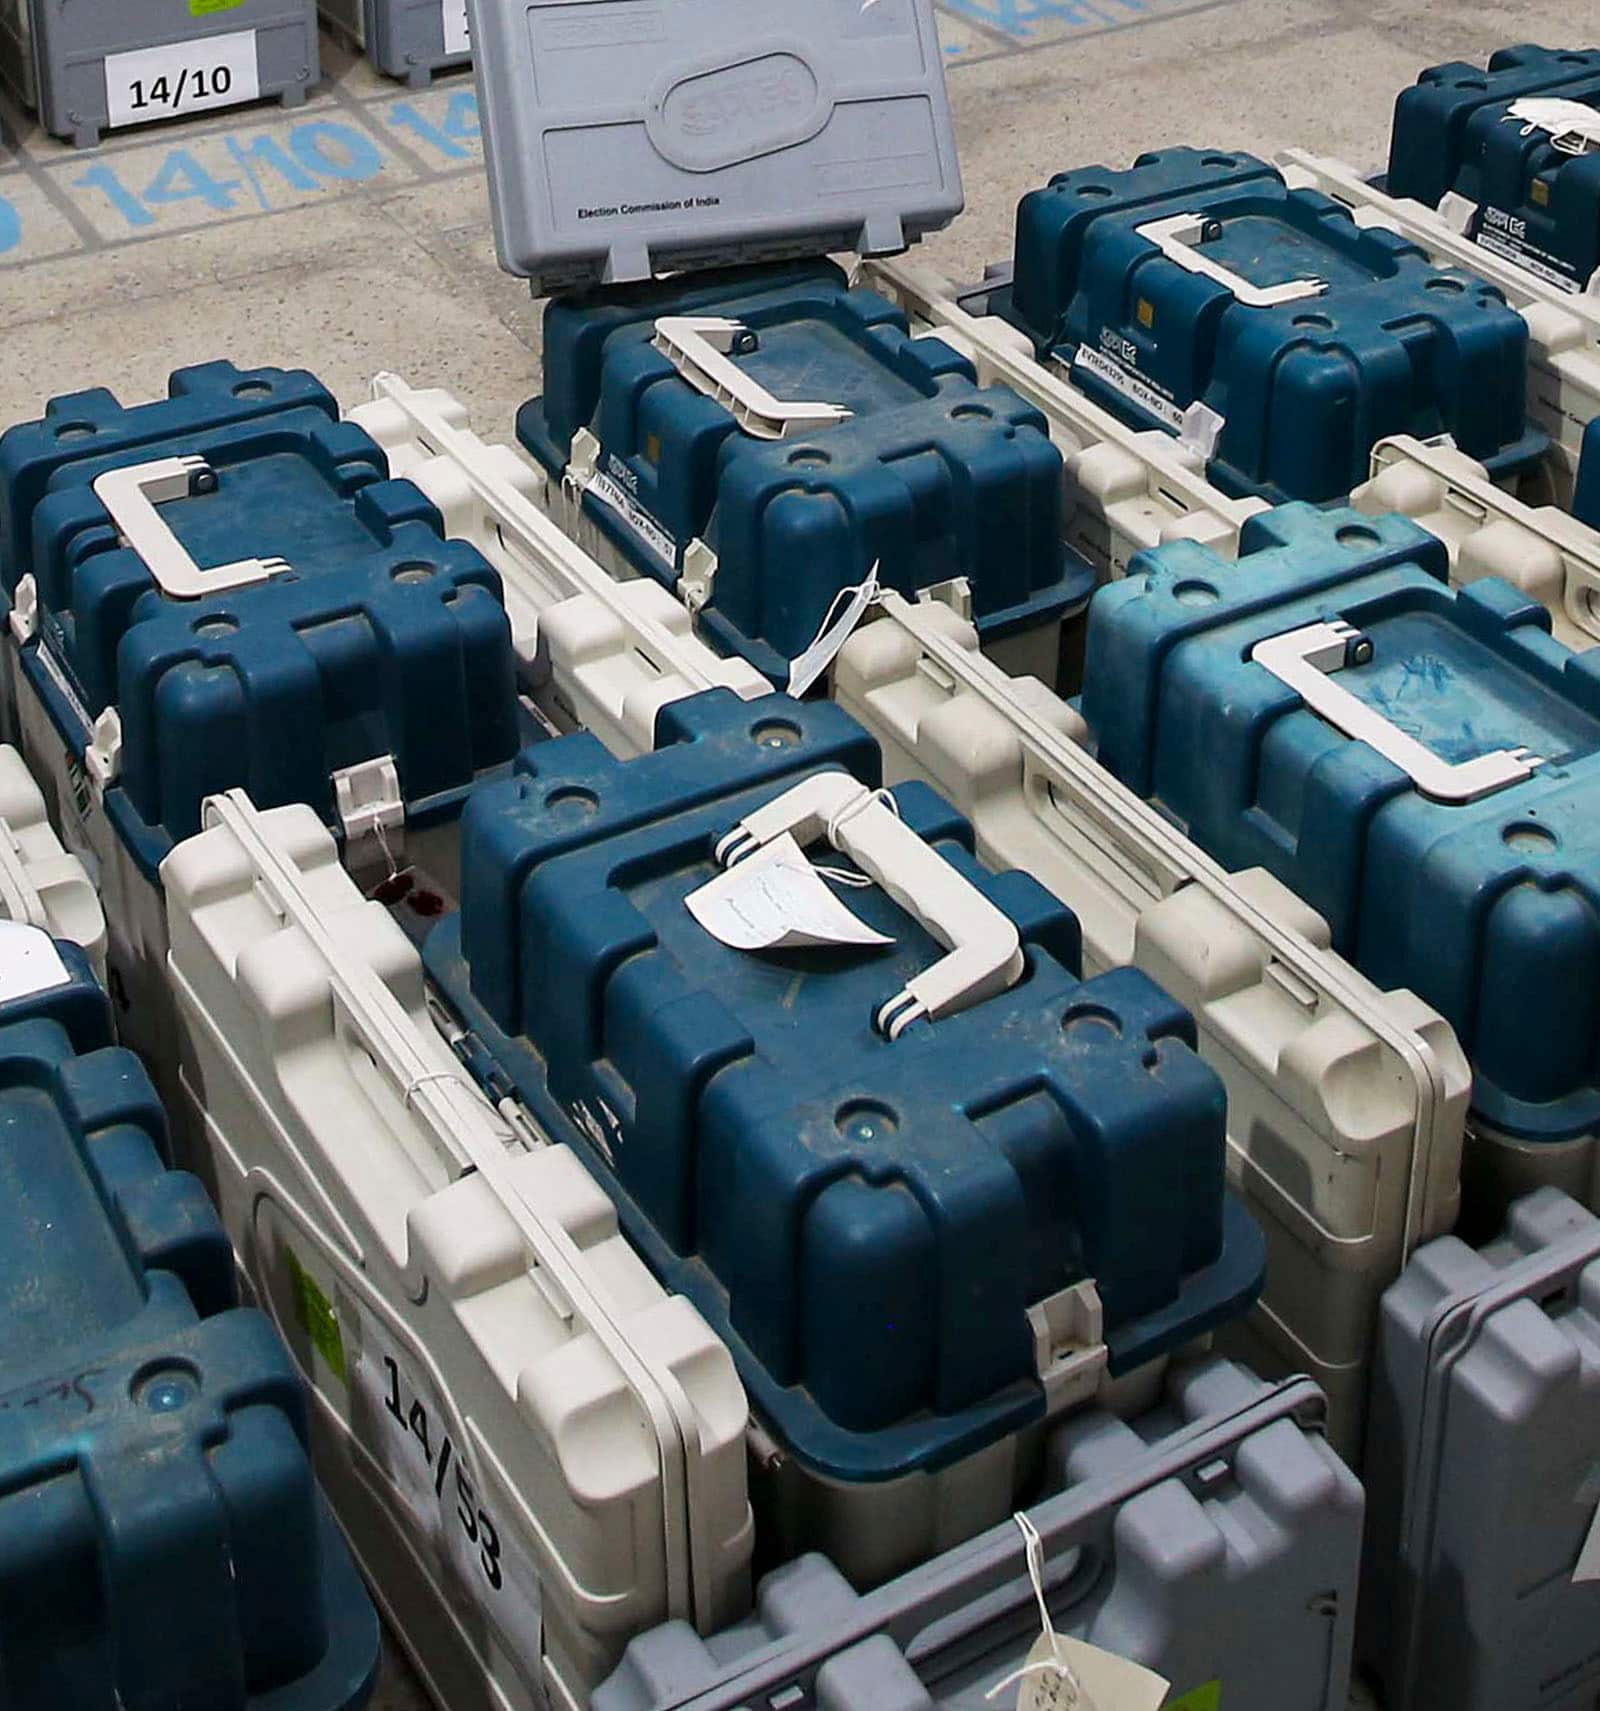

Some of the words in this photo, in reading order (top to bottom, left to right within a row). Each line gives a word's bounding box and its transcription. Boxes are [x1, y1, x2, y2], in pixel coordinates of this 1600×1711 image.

[128, 63, 233, 112] 14/10
[72, 118, 383, 229] 14/10
[577, 207, 619, 220] Election
[620, 200, 682, 216] Commission
[683, 197, 694, 209] of
[695, 195, 721, 208] India
[383, 1353, 507, 1593] 14/53
